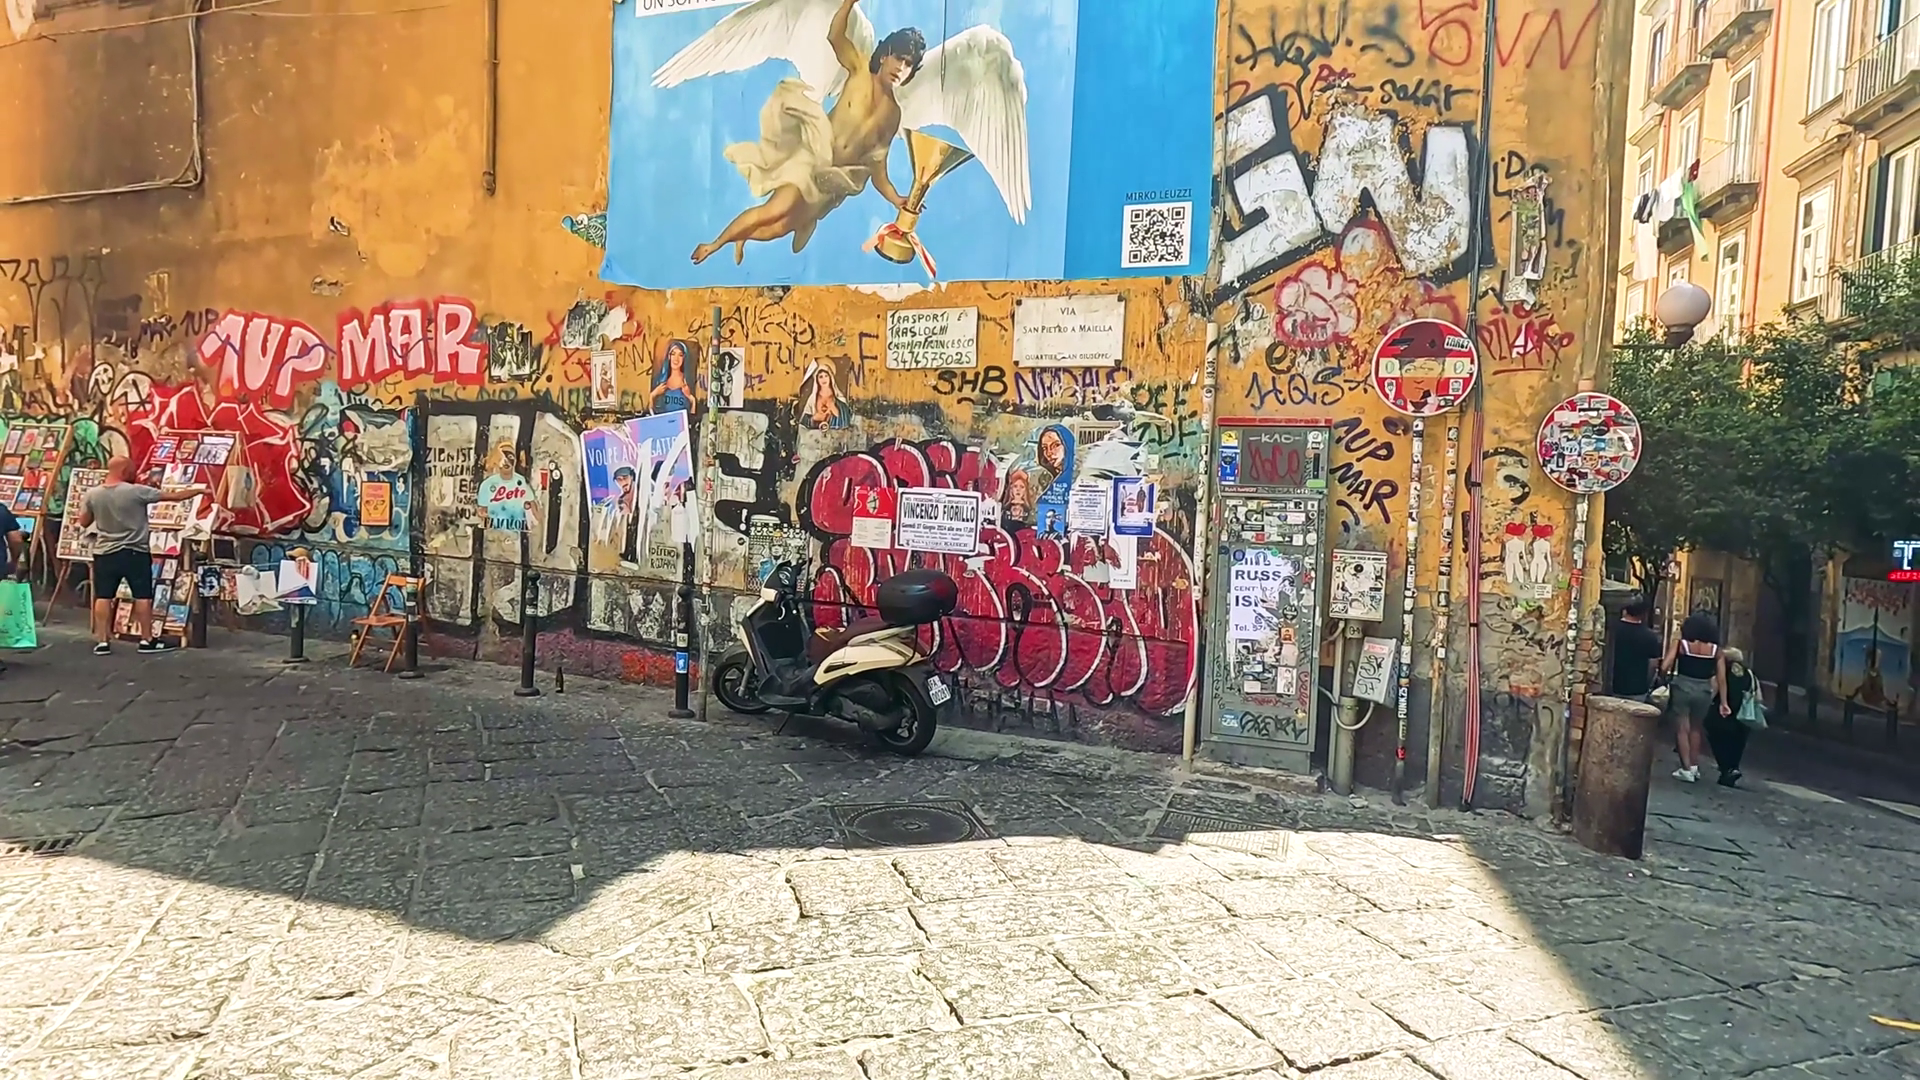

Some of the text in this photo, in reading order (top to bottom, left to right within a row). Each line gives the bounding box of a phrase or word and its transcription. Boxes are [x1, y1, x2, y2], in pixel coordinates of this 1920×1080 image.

[1126, 188, 1192, 201] MIRKO LEUZZI
[890, 310, 949, 324] TRASPORTI
[1060, 307, 1076, 315] VIA
[888, 323, 948, 339] TRASLOCHI
[1023, 326, 1039, 334] SAN
[1041, 325, 1068, 333] PIETRO
[1079, 324, 1113, 332] MAIELLA
[197, 295, 486, 406] 1UP MAR
[891, 351, 973, 368] 3474575025
[933, 366, 1009, 395] SHB
[1333, 417, 1395, 462] 1UP
[588, 446, 619, 468] VOLPE
[1329, 462, 1398, 524] MAR
[903, 502, 939, 520] VINCENZO
[942, 504, 976, 523] FIORILLO
